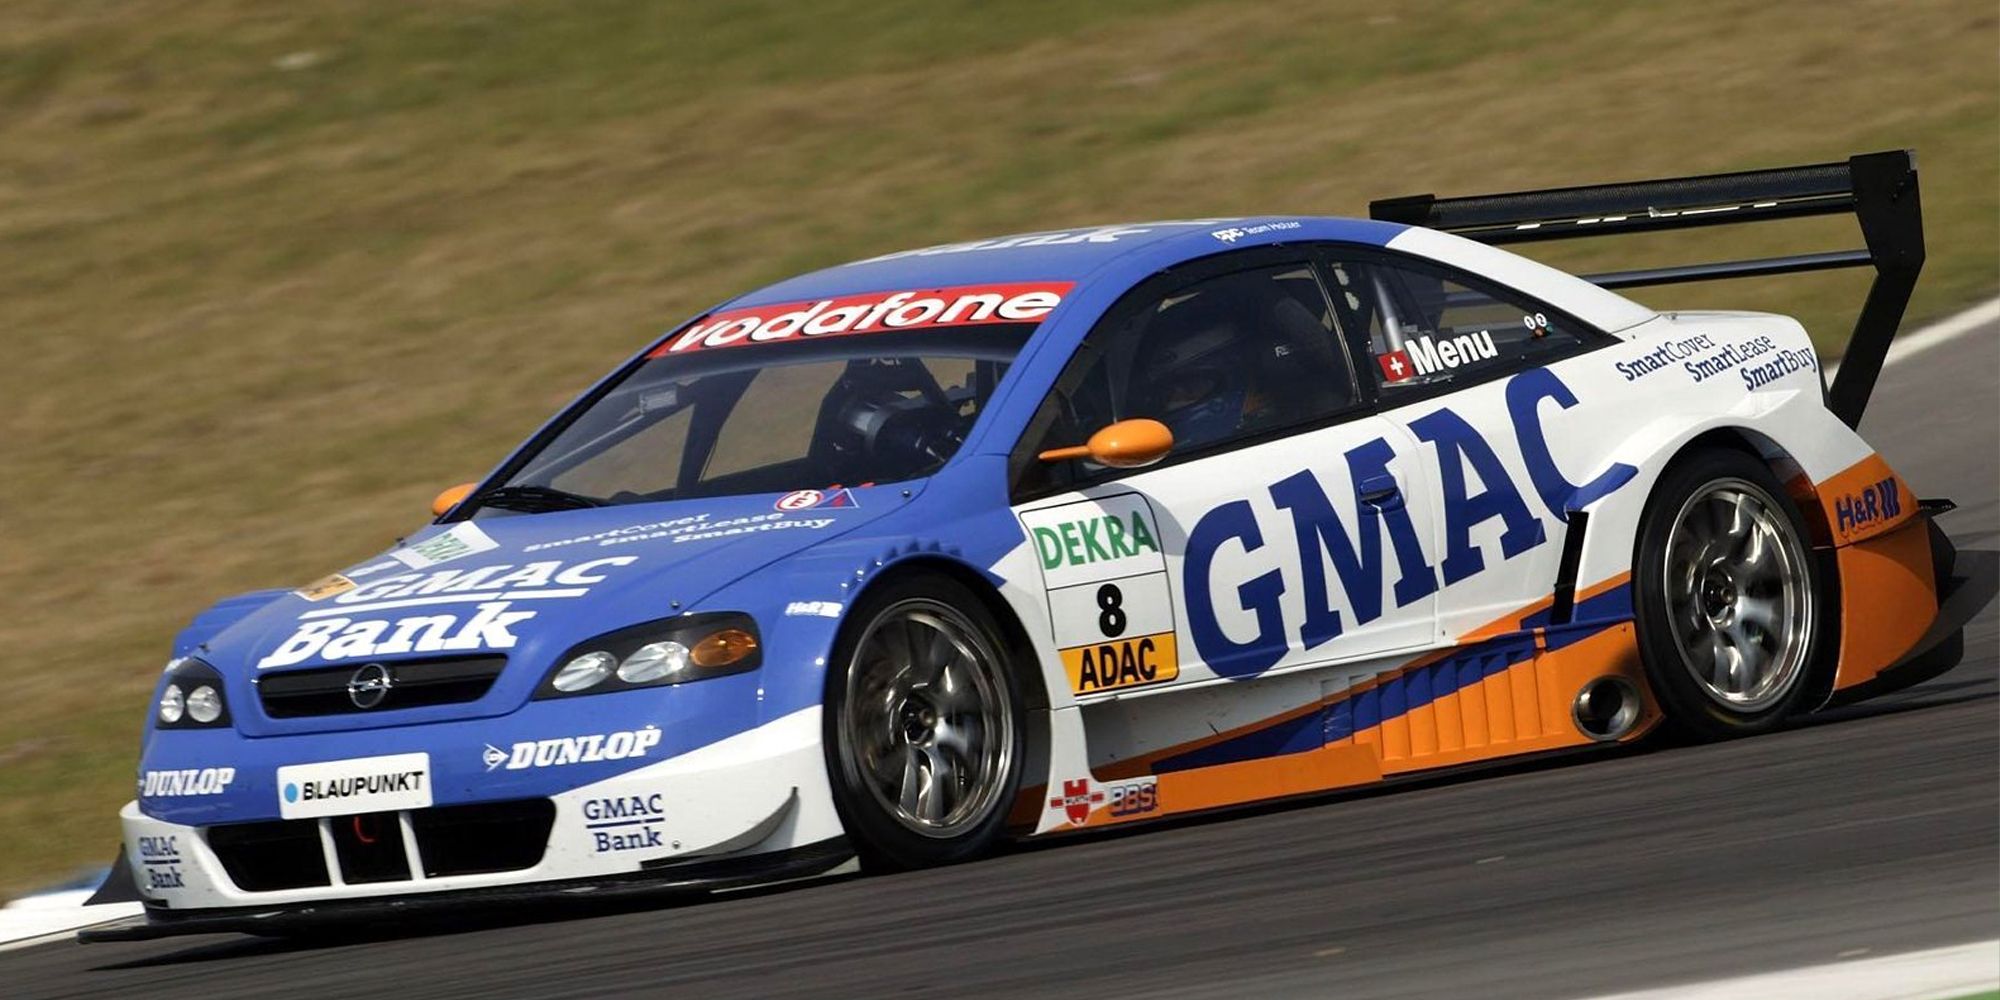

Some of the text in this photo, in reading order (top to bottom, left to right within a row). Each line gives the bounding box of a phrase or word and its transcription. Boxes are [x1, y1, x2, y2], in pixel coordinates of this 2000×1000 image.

[669, 291, 1061, 352] vodafone
[1404, 330, 1498, 375] Menu
[1615, 333, 1716, 382] SmartCover
[1684, 335, 1776, 383] SmartLease
[1740, 347, 1817, 392] SmartBuy
[672, 518, 836, 543] SmartBuy
[1183, 366, 1639, 681] GMAC
[1836, 488, 1880, 532] H&R
[1033, 511, 1158, 570] DEKRA
[335, 556, 639, 603] GMAC
[1097, 583, 1127, 638] 8
[260, 601, 537, 669] Bank
[1079, 638, 1157, 690] ADAC
[506, 728, 662, 770] DUNLOP
[143, 767, 236, 797] DUNLOP
[303, 771, 424, 801] BLAUPUNKT
[1110, 784, 1158, 817] BBS
[584, 794, 663, 820] GMAC
[139, 836, 179, 858] GMAC
[594, 827, 662, 852] Bank
[148, 866, 184, 888] Bank
